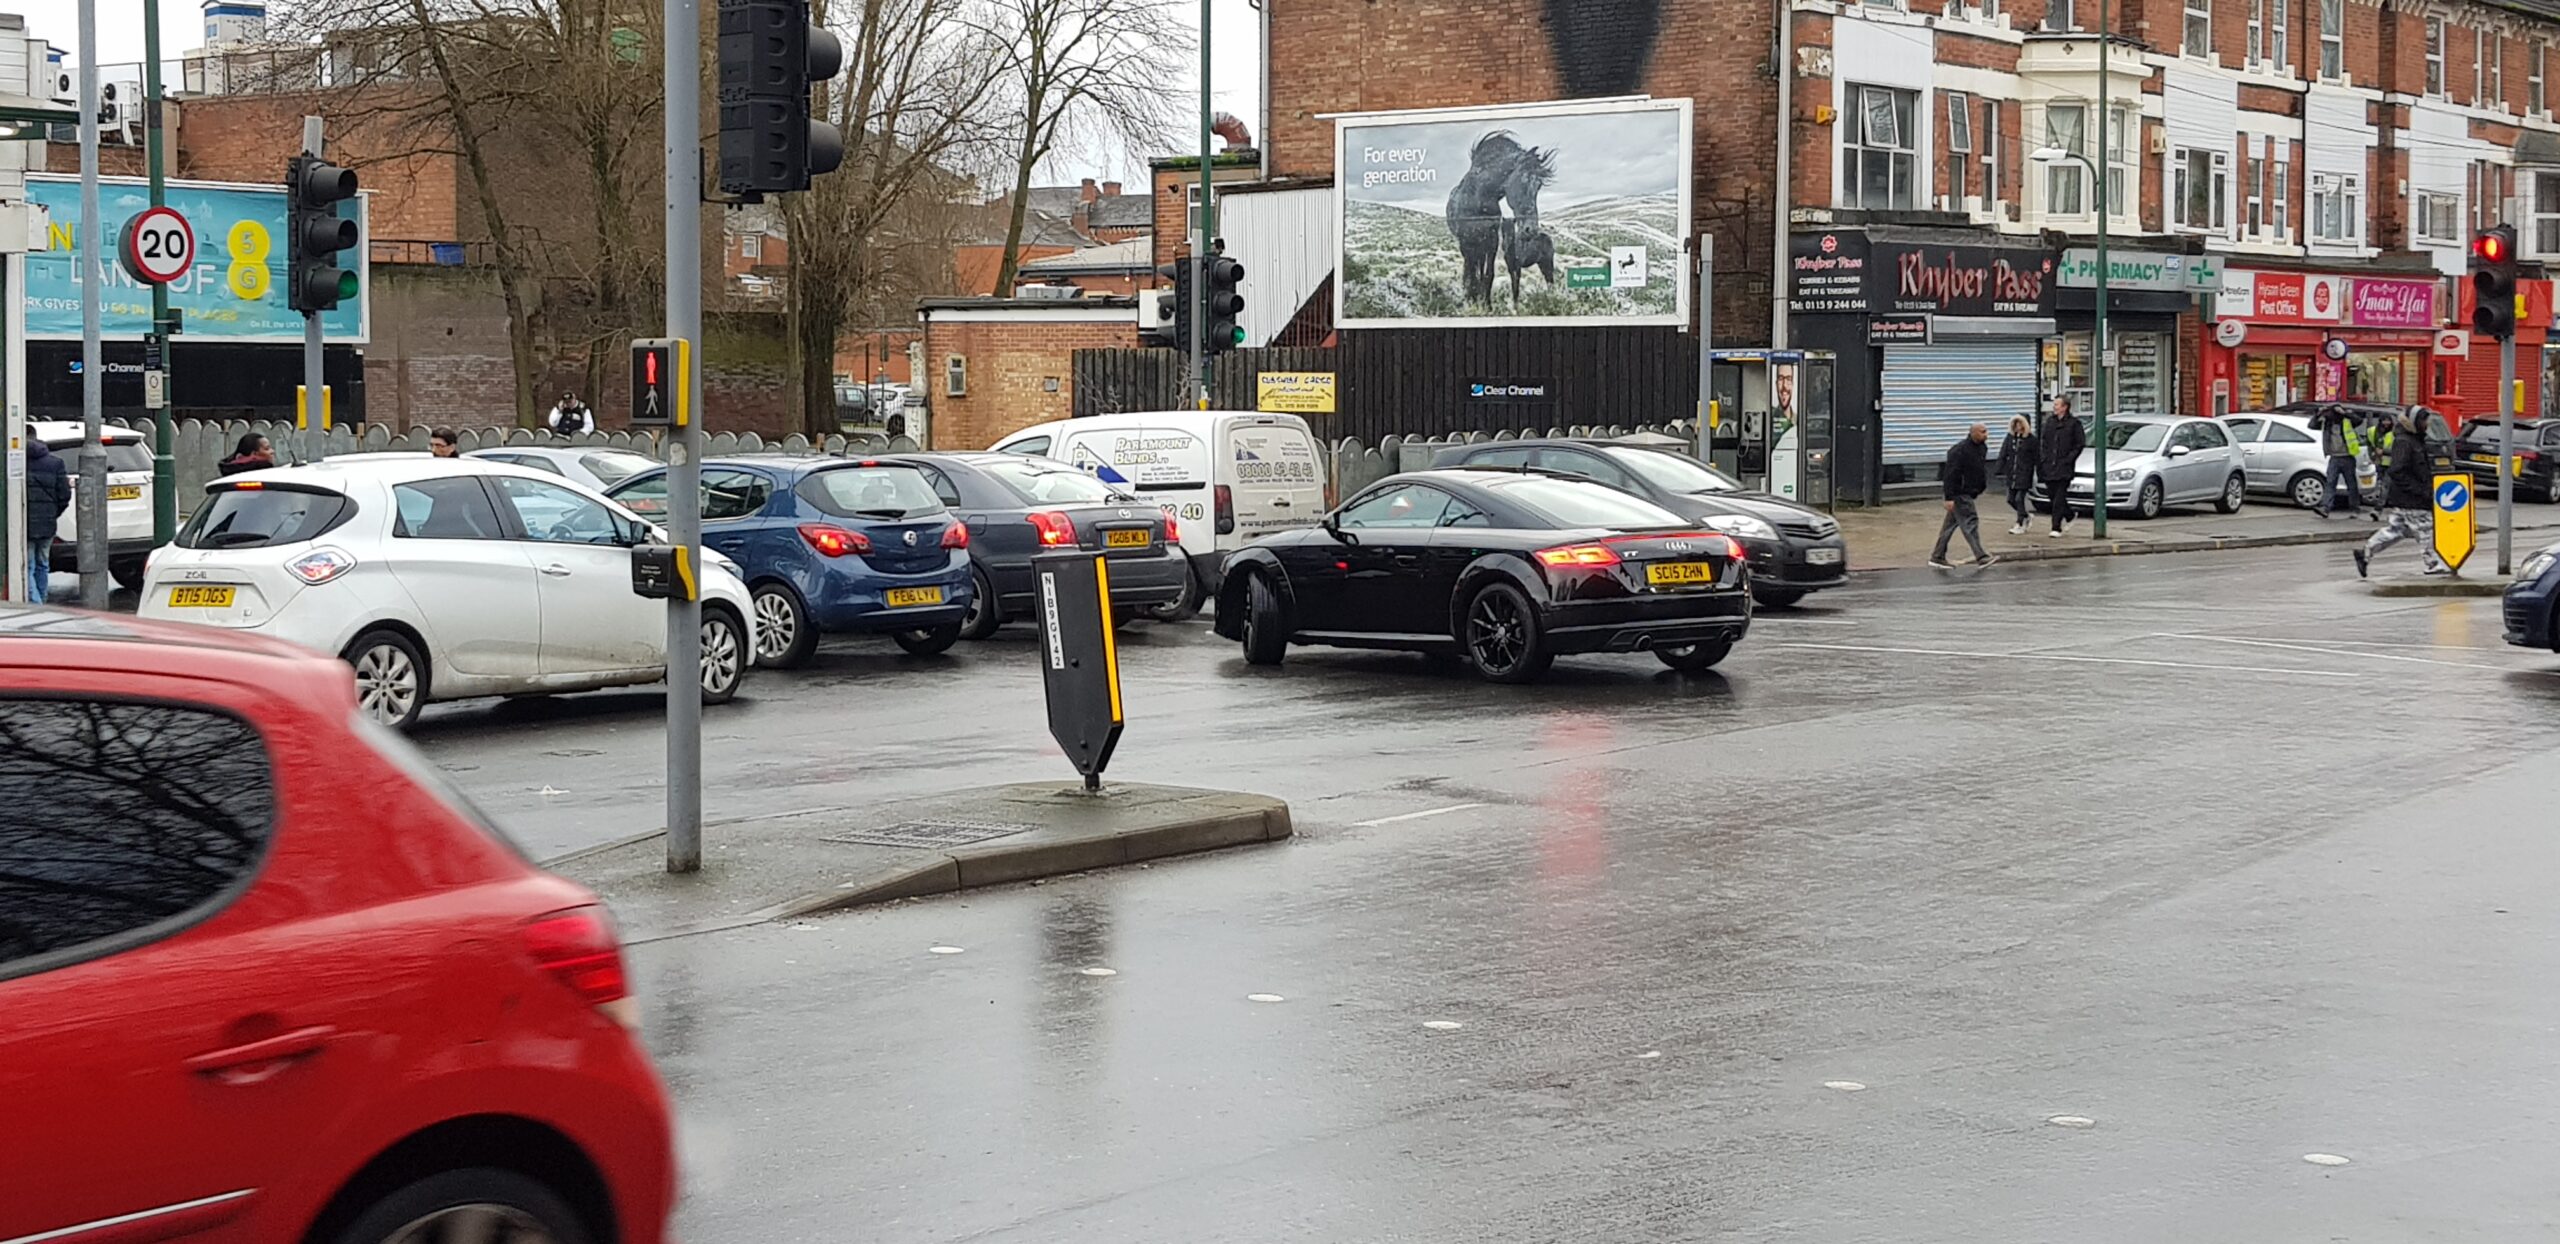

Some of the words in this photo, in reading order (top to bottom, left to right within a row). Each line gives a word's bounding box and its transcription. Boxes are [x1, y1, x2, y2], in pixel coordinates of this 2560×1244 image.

[1364, 147, 1386, 164] For
[1388, 148, 1427, 166] every
[1363, 166, 1437, 188] generation
[142, 229, 186, 259] 20
[1794, 255, 1837, 273] Khyber
[1838, 256, 1863, 270] Pass
[2079, 260, 2163, 282] PHARMACY
[70, 254, 151, 291] LAN
[1798, 276, 1826, 285] CURRIES
[1833, 275, 1861, 284] KEBABS
[1898, 248, 1989, 309] Khyber
[1992, 258, 2044, 300] Pass
[1798, 287, 1811, 296] EAT
[2257, 281, 2279, 299] Hyson
[2279, 282, 2301, 297] Green
[2355, 283, 2394, 312] Iman
[43, 298, 81, 311] GIVES
[1790, 301, 1804, 309] Tel:
[1805, 300, 1826, 309] 0115
[1826, 300, 1833, 309] 9
[1834, 300, 1850, 309] 244
[1851, 299, 1867, 309] 044
[2260, 300, 2276, 315] Post
[2276, 300, 2298, 316] Office
[108, 362, 145, 374] Channel
[1484, 385, 1507, 396] Clear
[1508, 385, 1544, 396] Channel
[1115, 437, 1193, 452] PARAMOUNT
[1113, 451, 1158, 465] BLINDS
[1181, 502, 1204, 521] 40
[1108, 531, 1130, 544] YG06
[1622, 549, 1639, 558] TT
[1654, 565, 1680, 580] SC15
[1683, 564, 1705, 579] ZHN
[175, 587, 201, 604] BT15
[893, 590, 917, 604] FE16
[918, 589, 937, 603] LYV
